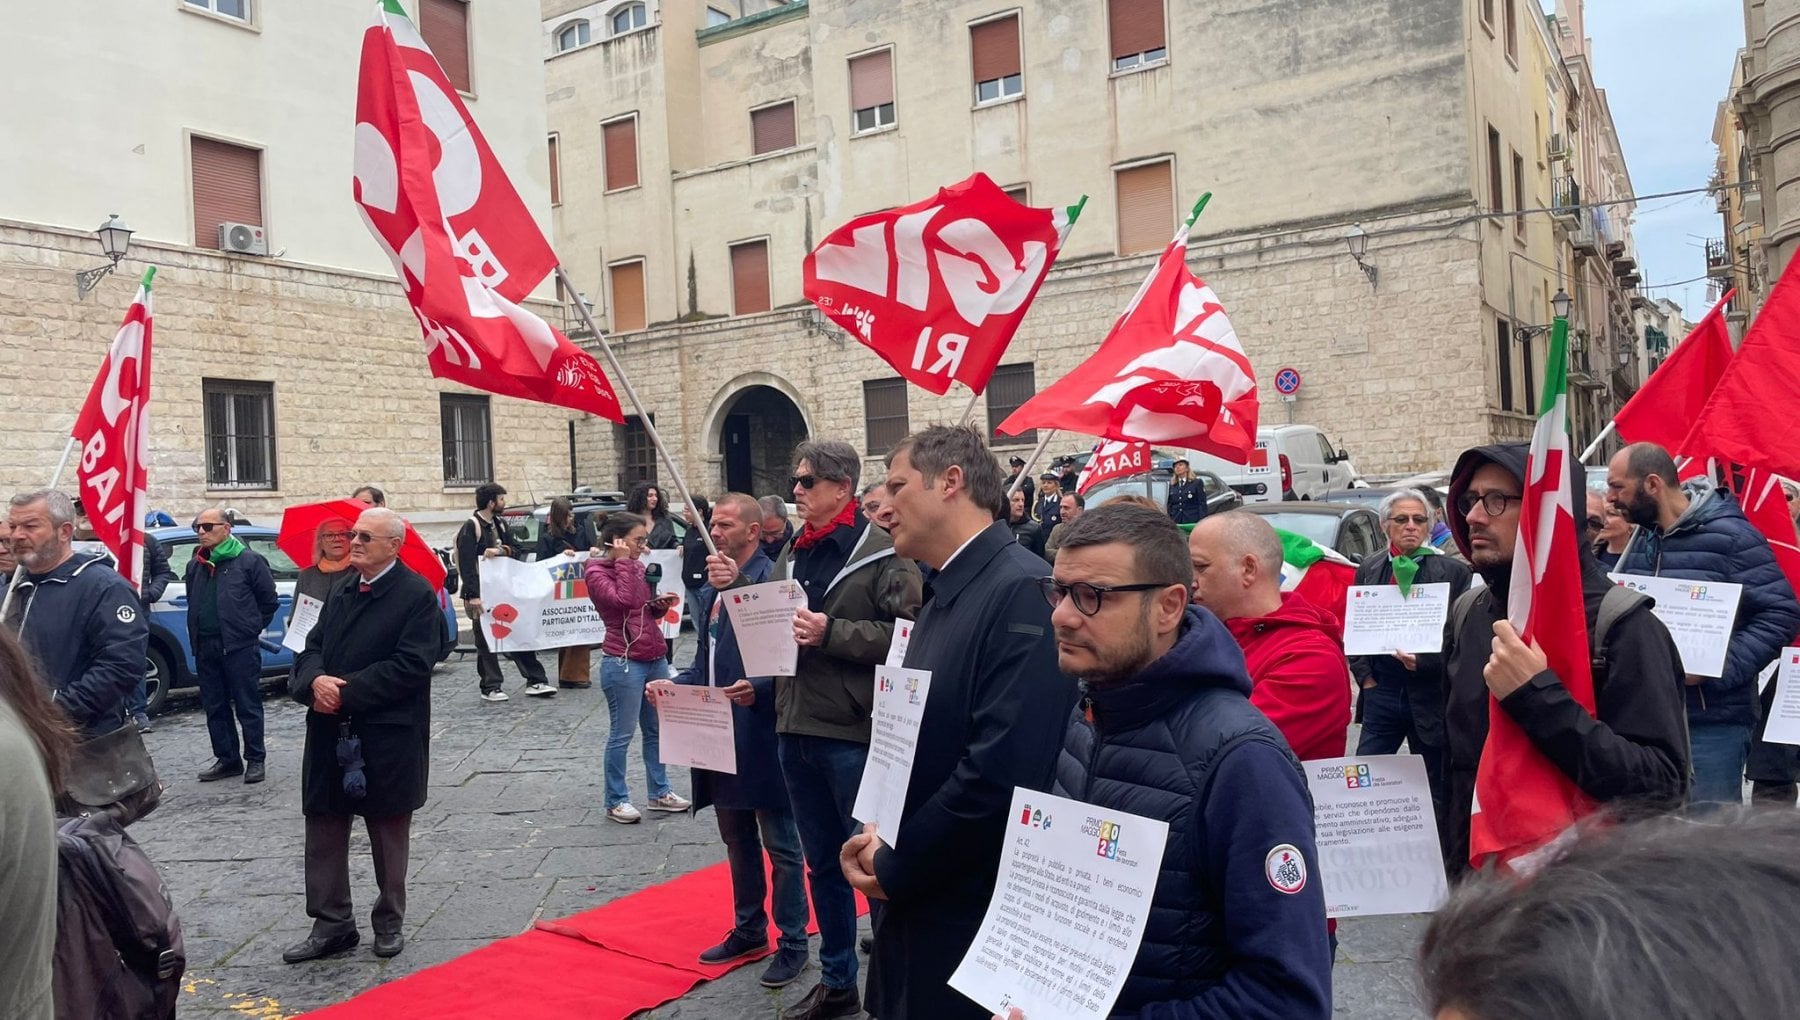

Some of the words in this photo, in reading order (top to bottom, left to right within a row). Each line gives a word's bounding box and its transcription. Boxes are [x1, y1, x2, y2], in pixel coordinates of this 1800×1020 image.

[542, 606, 587, 616] ASSOCIAZIONE
[542, 617, 576, 626] PARTIGIANI
[1321, 766, 1344, 774] PRIMO
[1336, 800, 1367, 808] riconosce
[1376, 797, 1410, 807] promuove
[1324, 811, 1344, 819] servizi
[1348, 809, 1360, 817] che
[1364, 806, 1400, 817] dipendono
[1403, 805, 1421, 813] dallo
[1086, 816, 1103, 828] PRIMO
[1393, 815, 1418, 824] adegua
[1081, 824, 1101, 838] MAGGIO
[1335, 827, 1375, 837] legislazione
[1378, 825, 1391, 833] alle
[1393, 823, 1424, 832] esigenze
[1117, 883, 1143, 898] economici
[1126, 914, 1136, 925] che
